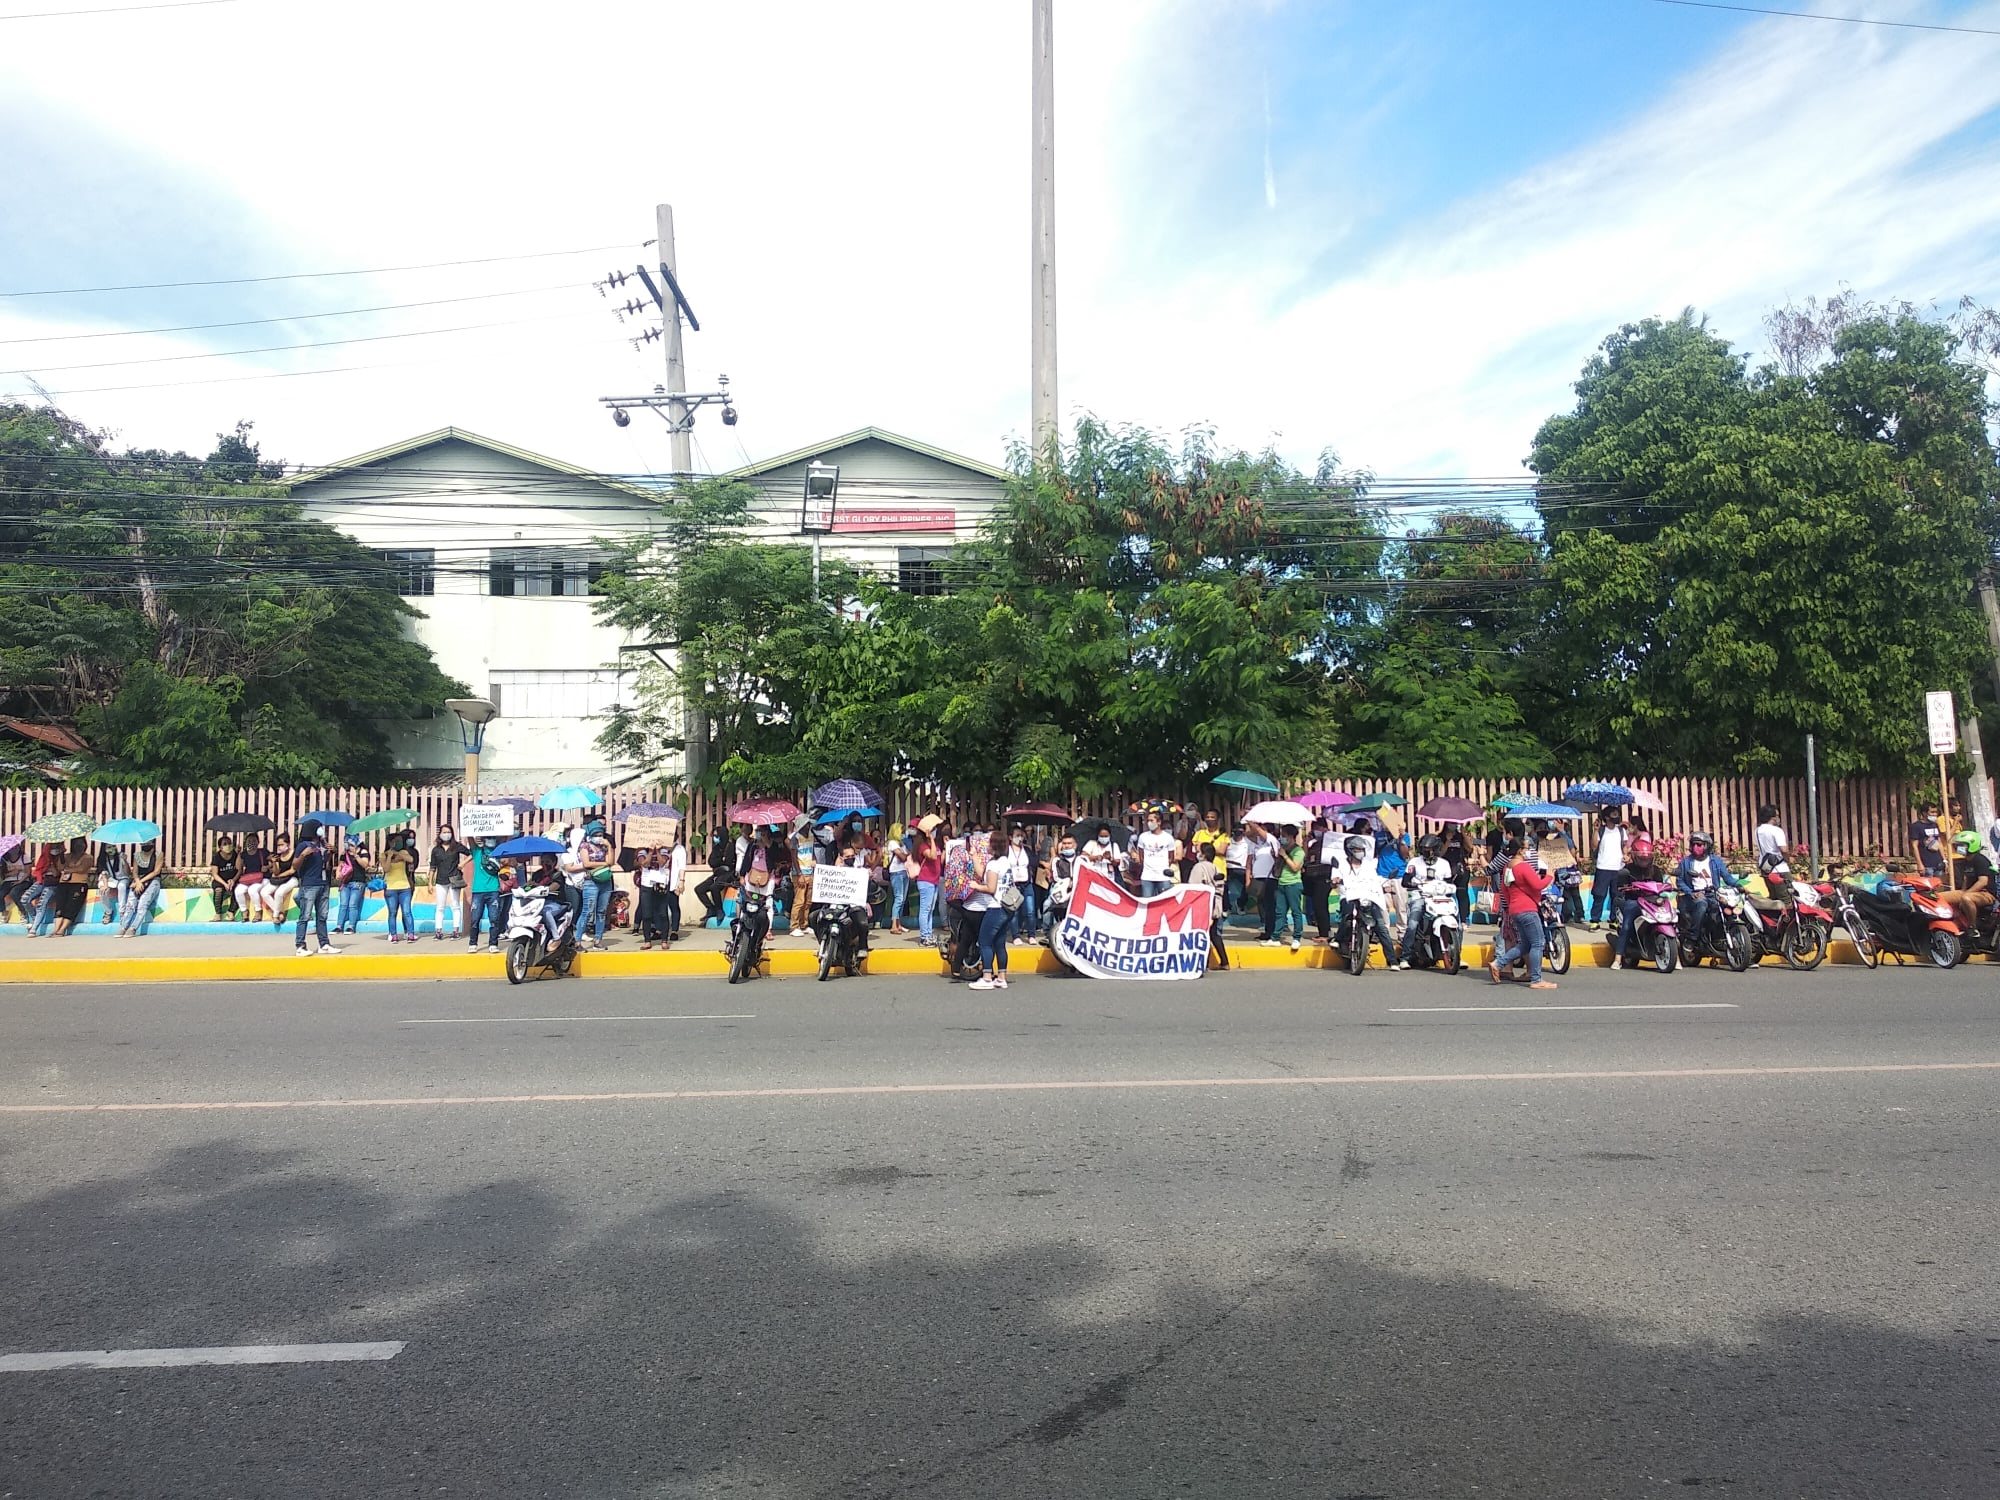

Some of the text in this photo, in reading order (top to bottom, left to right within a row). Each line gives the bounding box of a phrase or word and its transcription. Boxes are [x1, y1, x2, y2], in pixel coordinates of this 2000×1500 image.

[1069, 864, 1211, 937] PM
[1061, 933, 1206, 974] MANGGAGAWA
[1063, 917, 1208, 955] PARTIDO NG
